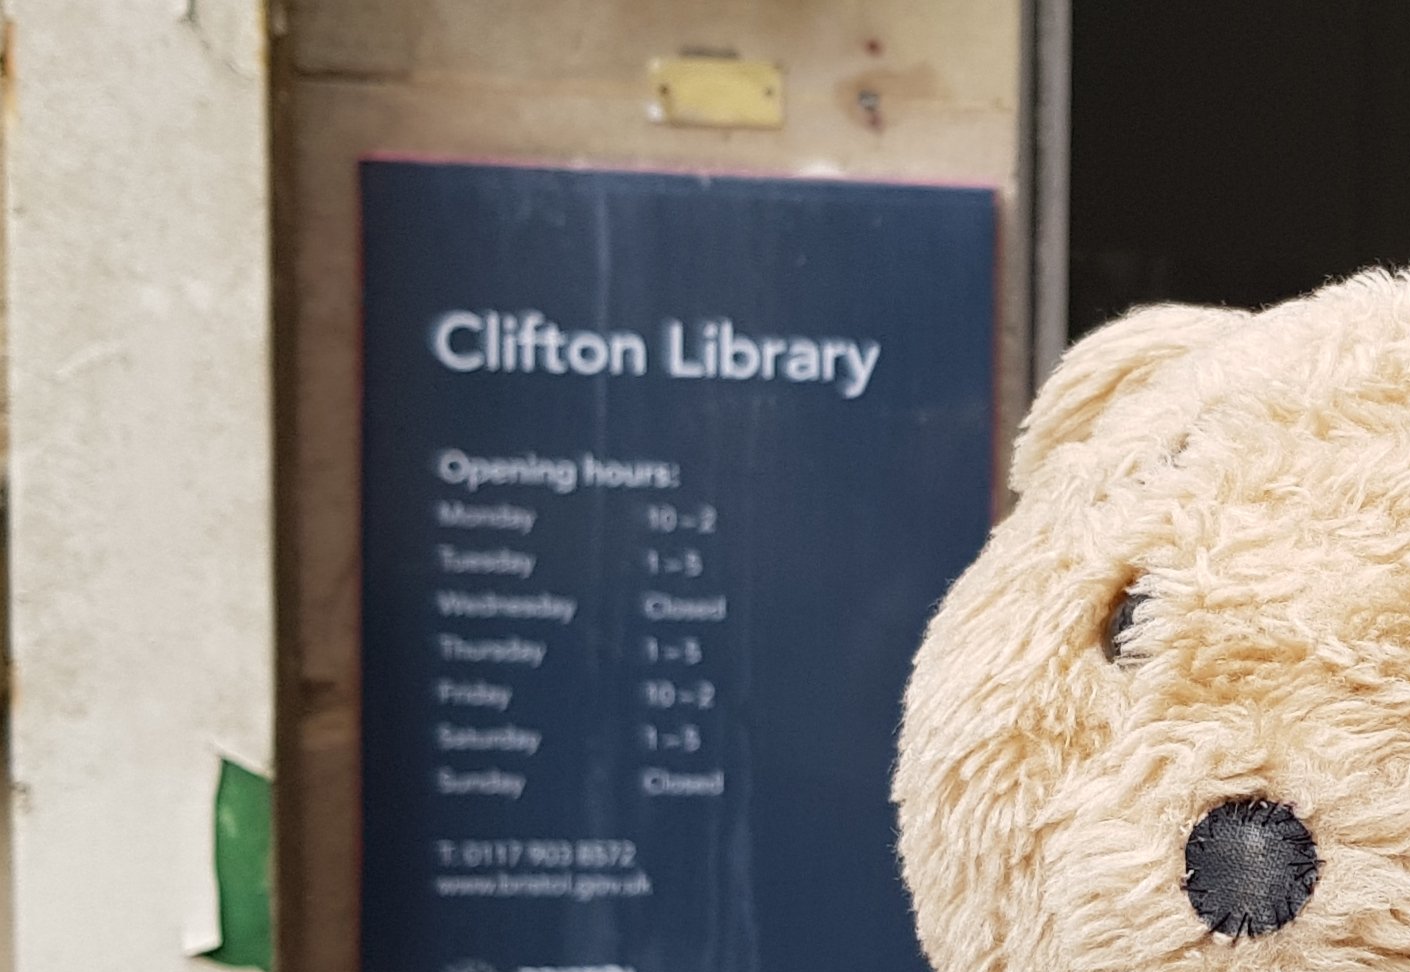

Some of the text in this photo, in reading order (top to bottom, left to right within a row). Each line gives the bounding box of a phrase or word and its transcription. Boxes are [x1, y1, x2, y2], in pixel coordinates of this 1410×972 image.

[432, 309, 881, 399] Clifton Library
[438, 449, 681, 493] Opening hours:
[437, 502, 537, 535] Monday
[648, 504, 677, 532] 10
[699, 504, 717, 534] 2
[438, 545, 536, 579] Tuesday
[438, 591, 727, 625] Wednesday Closed
[438, 635, 547, 669] Thursday
[438, 680, 513, 713] Friday
[646, 680, 676, 708] 10
[698, 680, 716, 710] 2
[438, 723, 542, 757] Saturday
[438, 767, 725, 800] Sunday Closed
[462, 840, 523, 868] 0117
[437, 871, 653, 902] www.bristol.gov.uk
